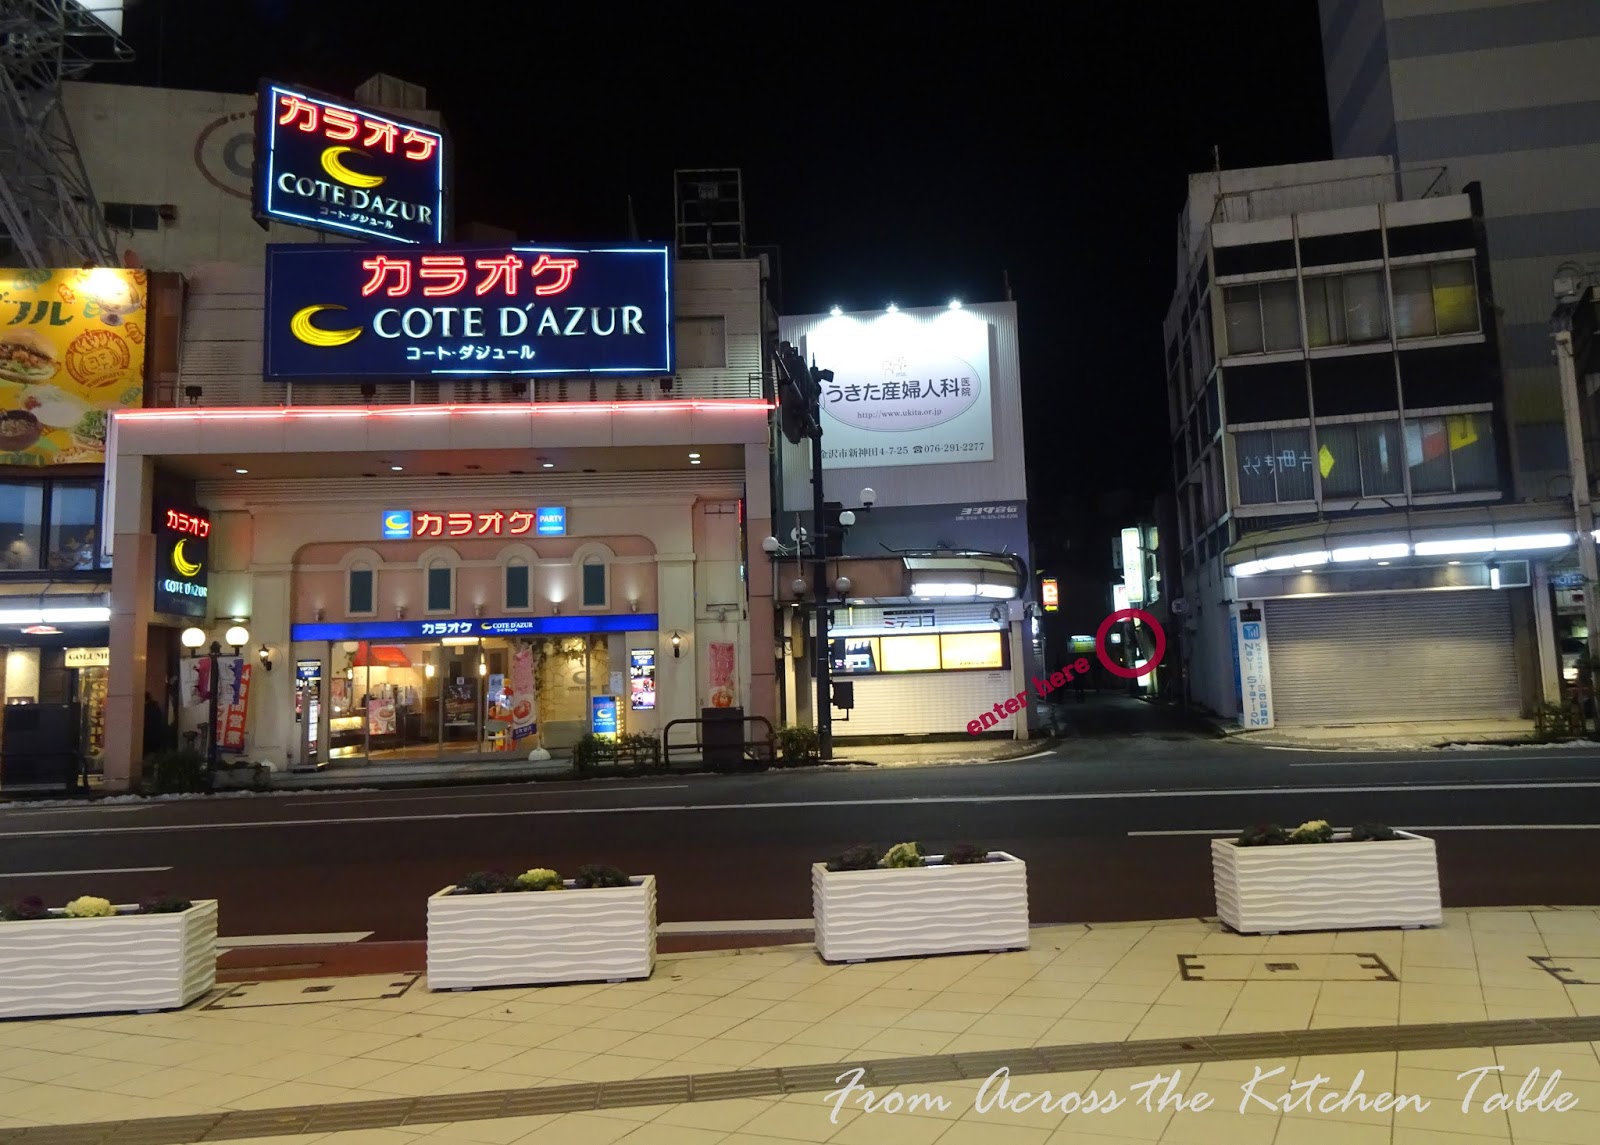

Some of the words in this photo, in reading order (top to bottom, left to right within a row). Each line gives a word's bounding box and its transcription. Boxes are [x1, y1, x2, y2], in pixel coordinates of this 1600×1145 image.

[279, 96, 437, 161] カラオケ
[277, 172, 346, 206] COTE
[350, 188, 433, 225] D'AZUR
[361, 253, 579, 297] カラオケ
[372, 306, 486, 339] COTE
[498, 302, 646, 337] D'AZUR
[825, 378, 960, 404] うきた産婦人科
[857, 408, 942, 419] http://www.ukita.or.jp
[924, 442, 985, 454] 076-291-2277
[166, 508, 210, 538] カラオケ
[416, 511, 535, 536] カラオケ
[539, 514, 563, 523] PARTY
[164, 579, 183, 593] COTE
[421, 621, 473, 635] カラオケ
